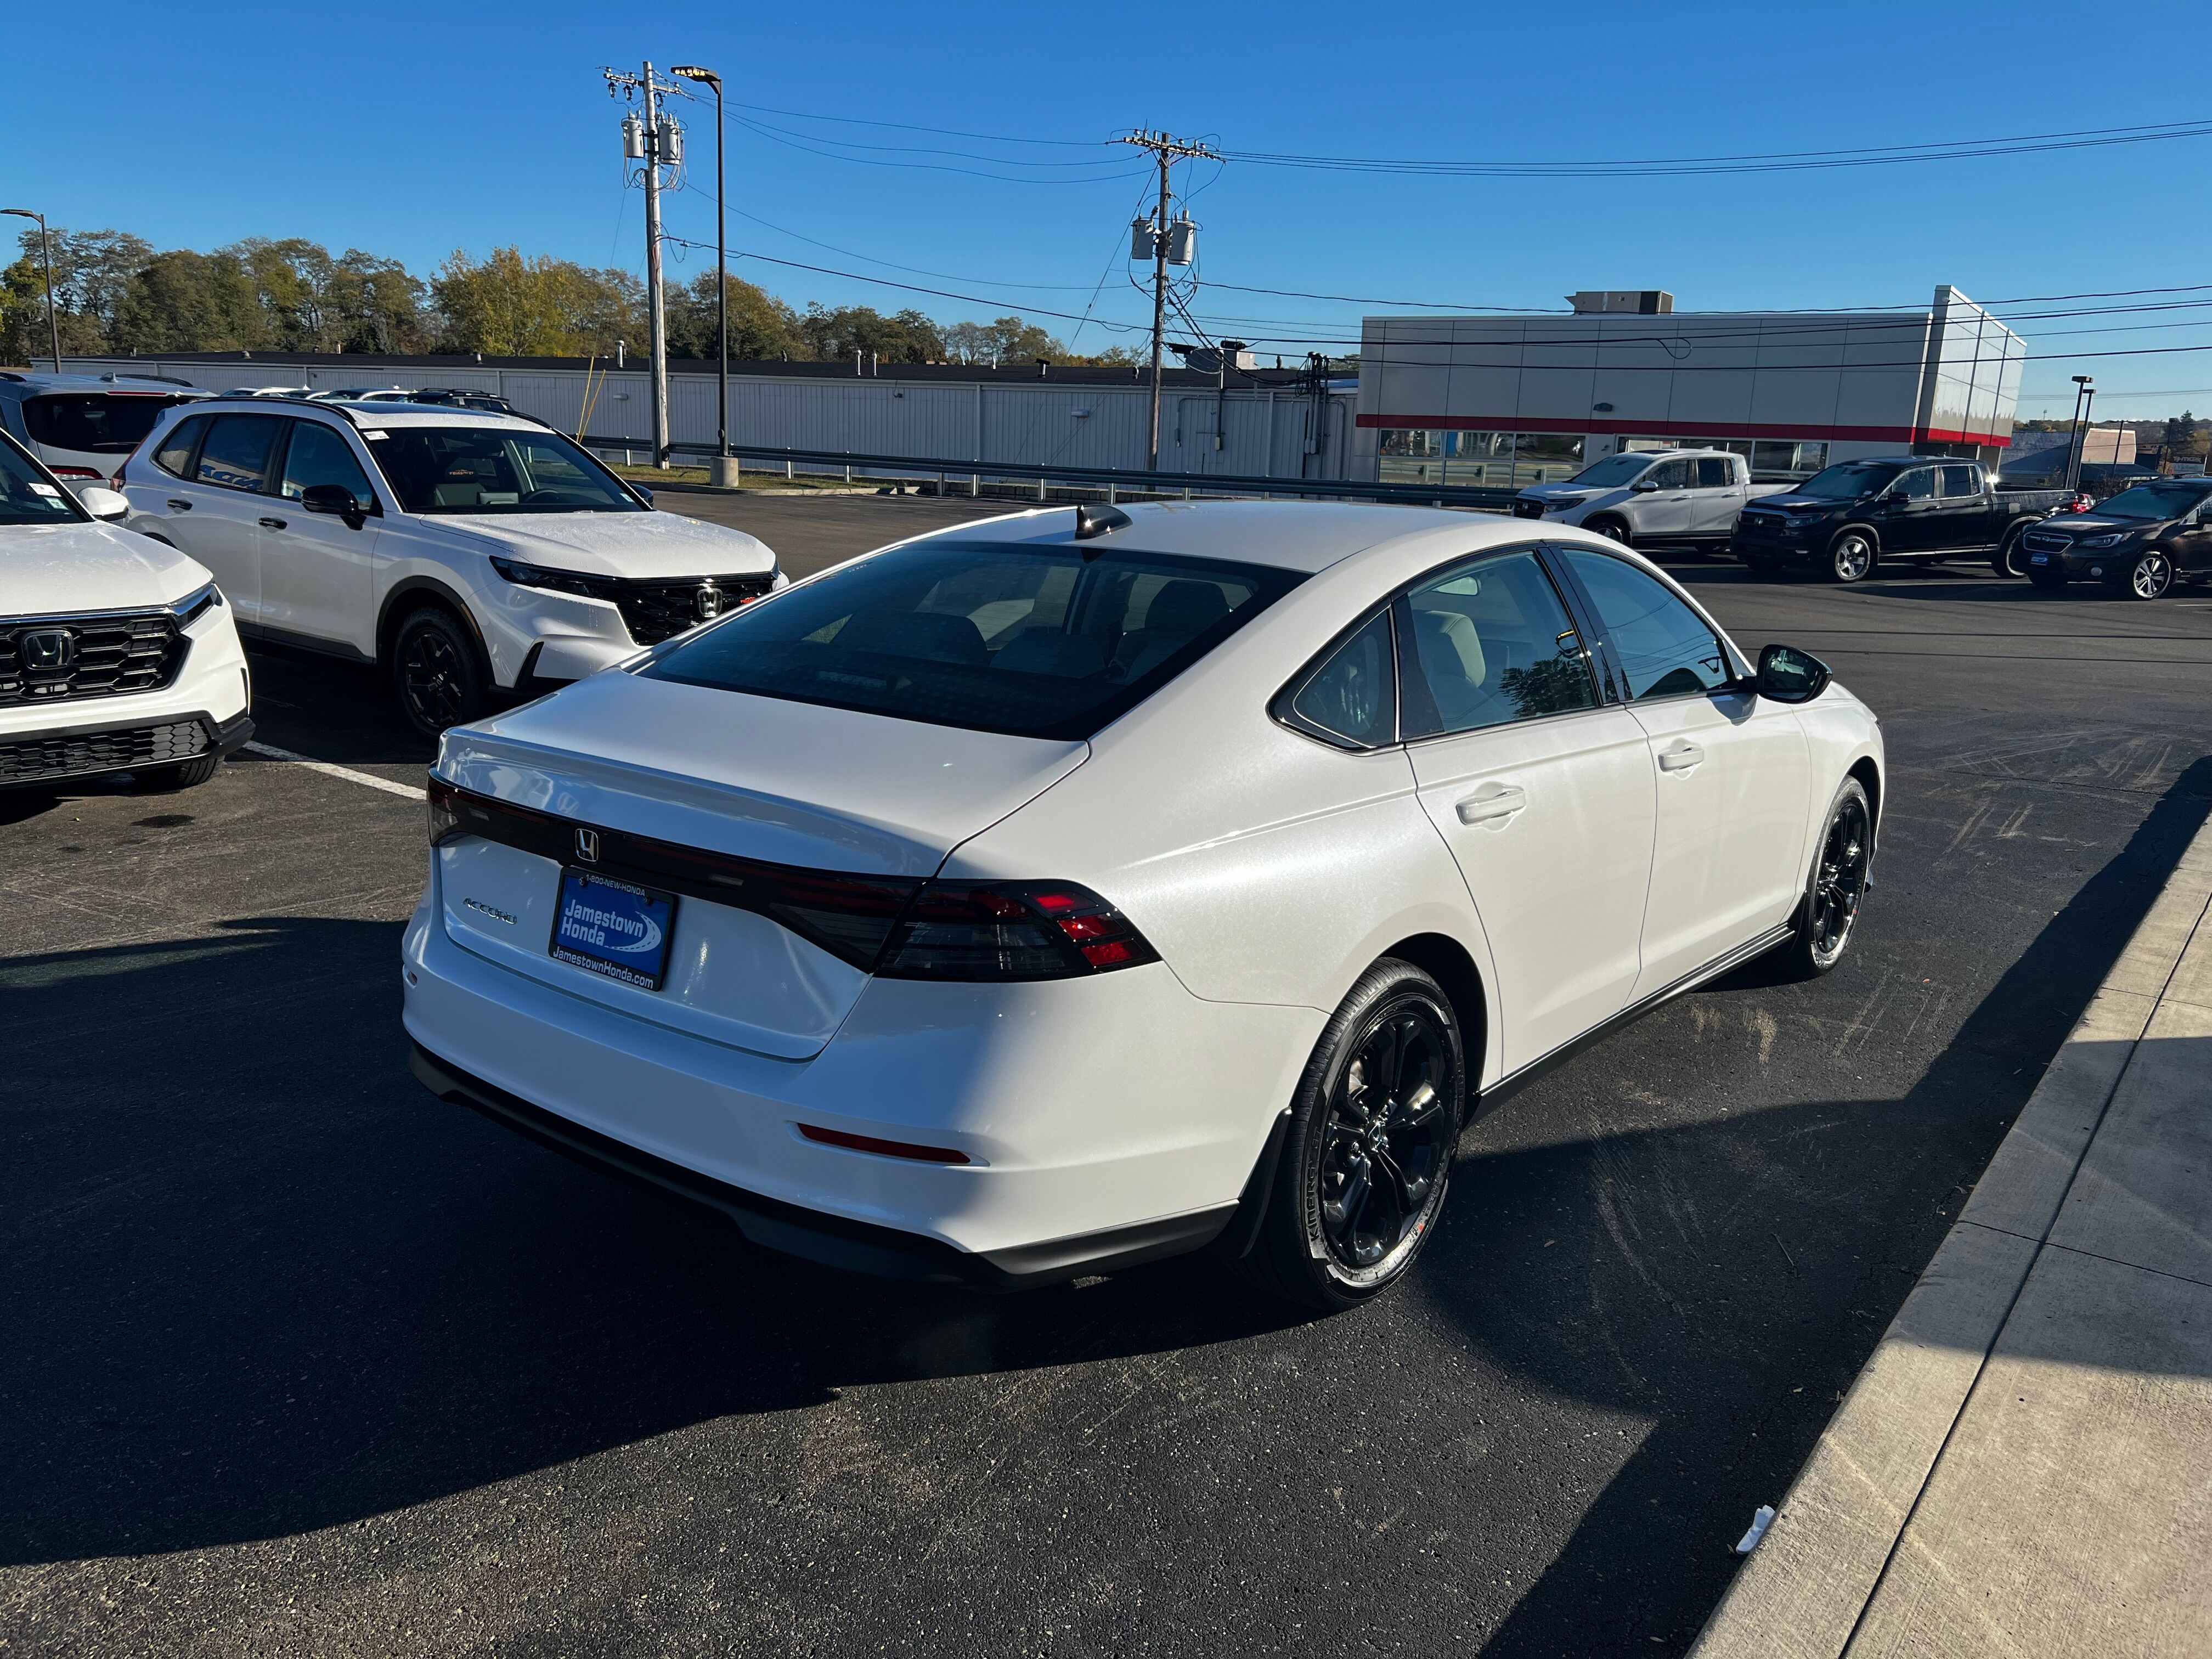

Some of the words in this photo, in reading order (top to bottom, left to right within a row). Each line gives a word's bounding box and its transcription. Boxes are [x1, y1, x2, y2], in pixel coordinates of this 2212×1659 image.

[586, 874, 646, 896] 1-800-NEW-HONDA
[462, 898, 517, 924] ACCORD
[565, 899, 644, 938] Jamestown
[561, 916, 605, 946] Honda
[553, 946, 653, 989] JamestownHonda.com
[1306, 1154, 1319, 1242] KINERGY
